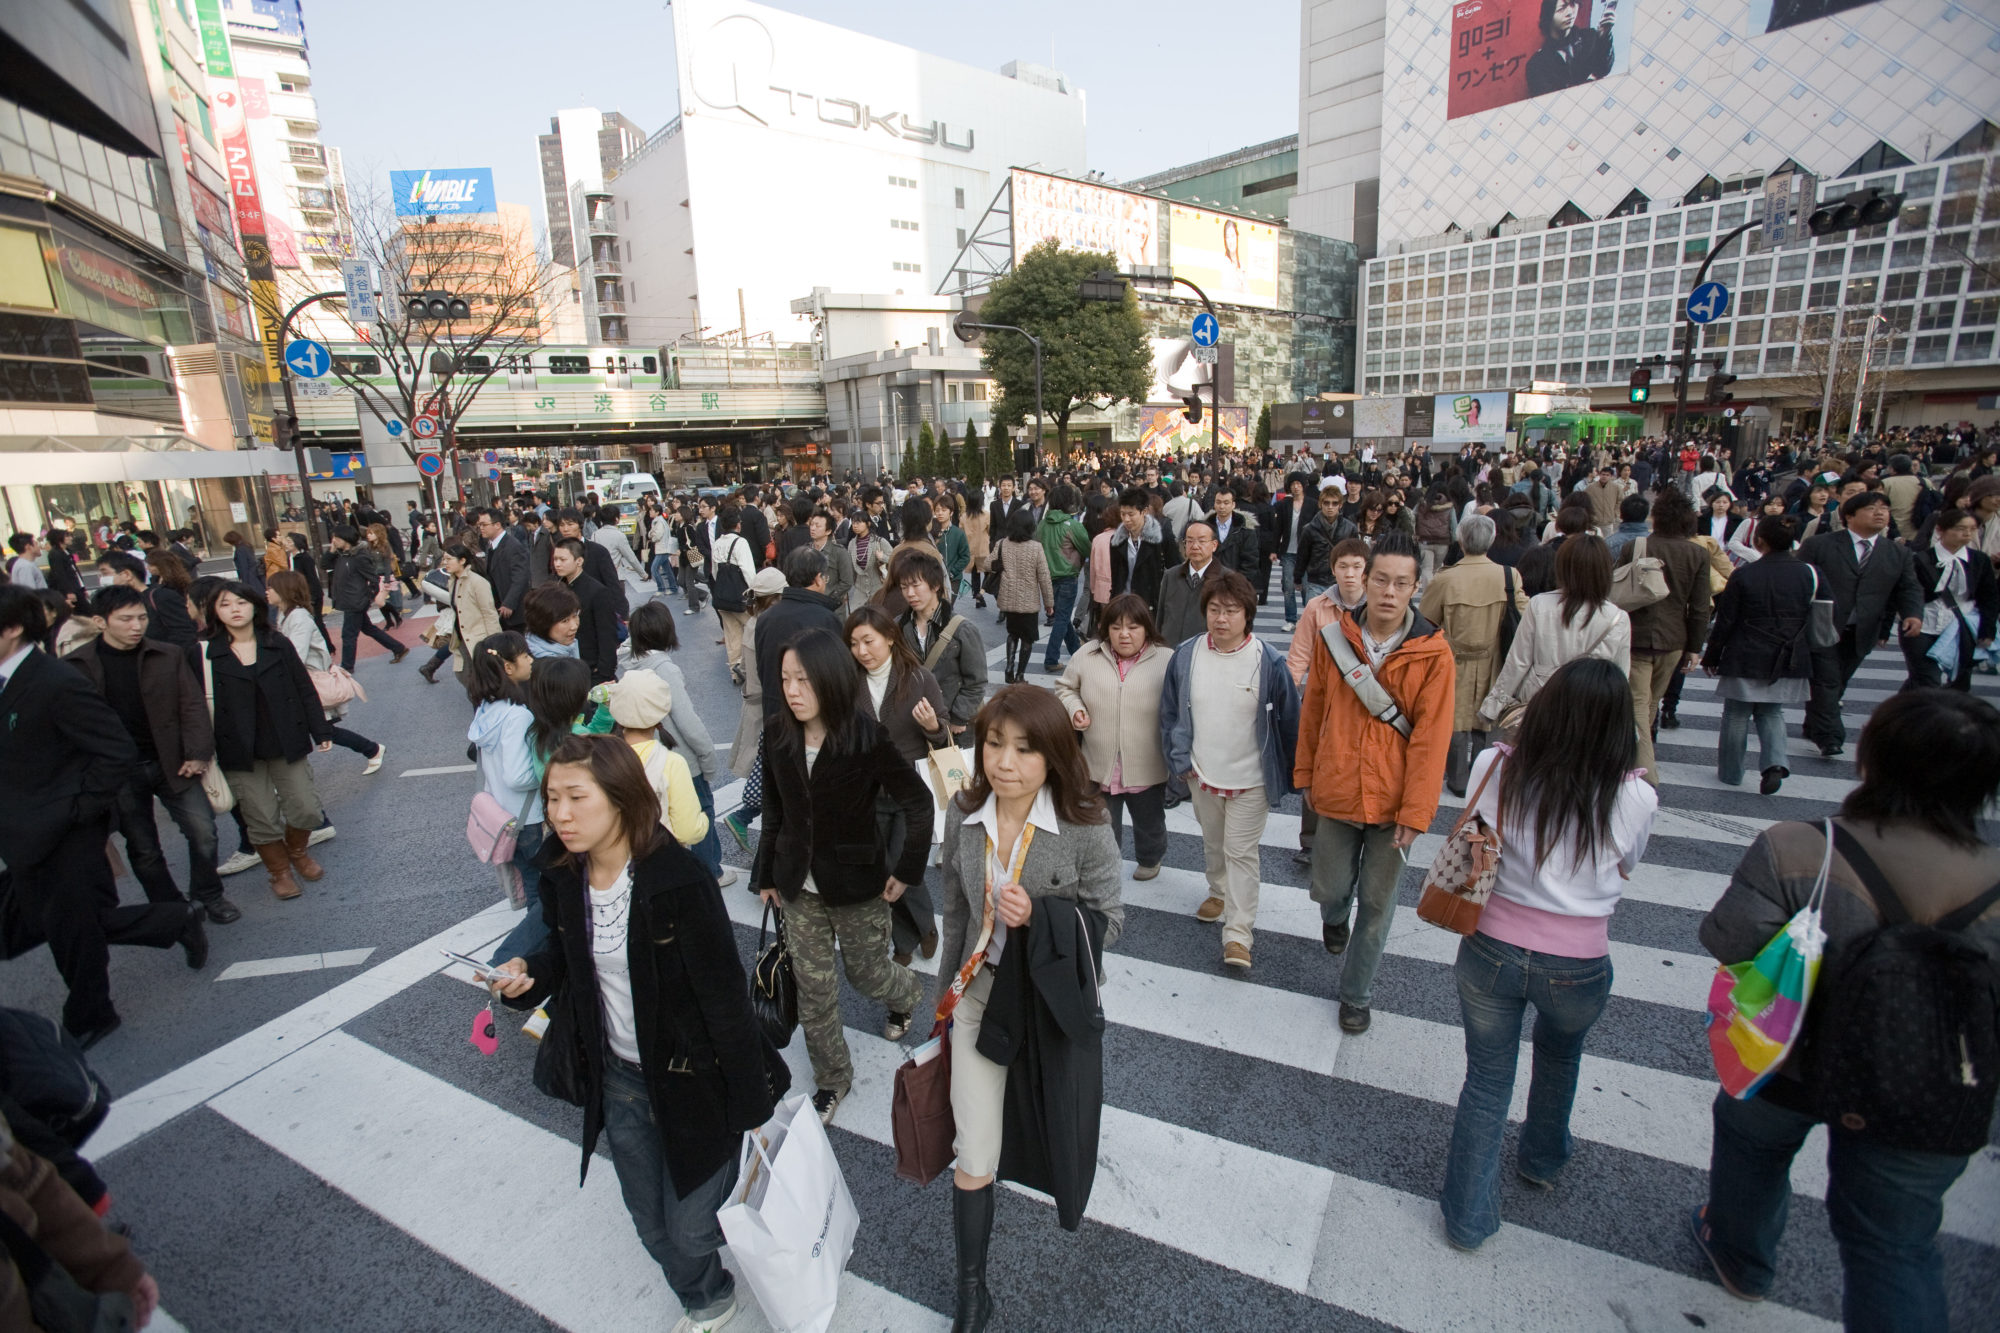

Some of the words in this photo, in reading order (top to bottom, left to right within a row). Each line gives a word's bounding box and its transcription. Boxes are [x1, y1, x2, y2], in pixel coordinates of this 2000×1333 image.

[1457, 54, 1527, 91] ワンセグ
[226, 147, 255, 197] アコム
[1773, 180, 1788, 240] 渋谷駅前
[354, 265, 373, 317] 渋谷駅前
[535, 397, 556, 408] JR
[593, 392, 720, 413] 渋谷駅
